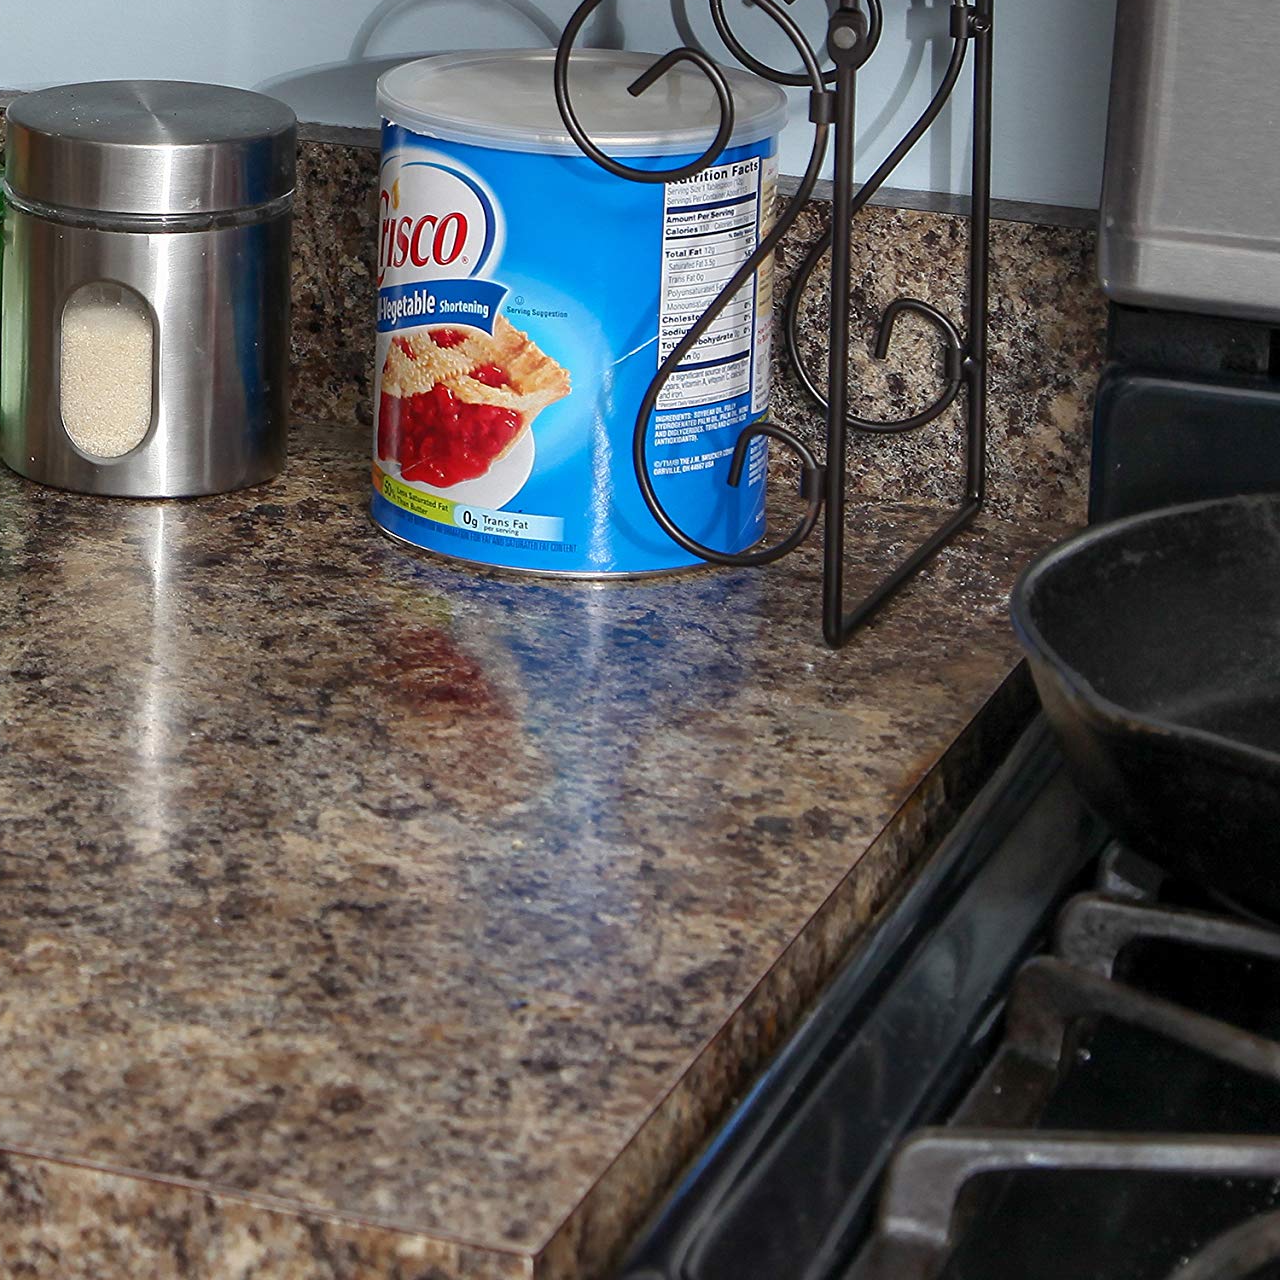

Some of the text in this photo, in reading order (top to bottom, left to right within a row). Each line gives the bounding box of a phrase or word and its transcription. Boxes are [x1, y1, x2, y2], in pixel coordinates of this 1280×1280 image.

[732, 161, 758, 176] Facts
[667, 185, 701, 195] Serving Size
[667, 195, 691, 206] Servings
[693, 194, 701, 202] Per
[666, 208, 735, 224] Amount Per Serving
[665, 226, 698, 236] Calories
[665, 247, 715, 258] Total Fat 12g
[668, 261, 695, 271] Saturated
[696, 260, 704, 268] Fat
[668, 273, 704, 284] Trans Fat 0g
[439, 299, 489, 318] Shortening
[506, 306, 568, 318] Serving Suggestion
[397, 486, 407, 497] Less
[408, 492, 436, 508] Saturated
[438, 502, 449, 512] Fat
[397, 496, 428, 515] Than Butter
[463, 510, 528, 530] 0g Trans Fat
[495, 527, 519, 536] serving
